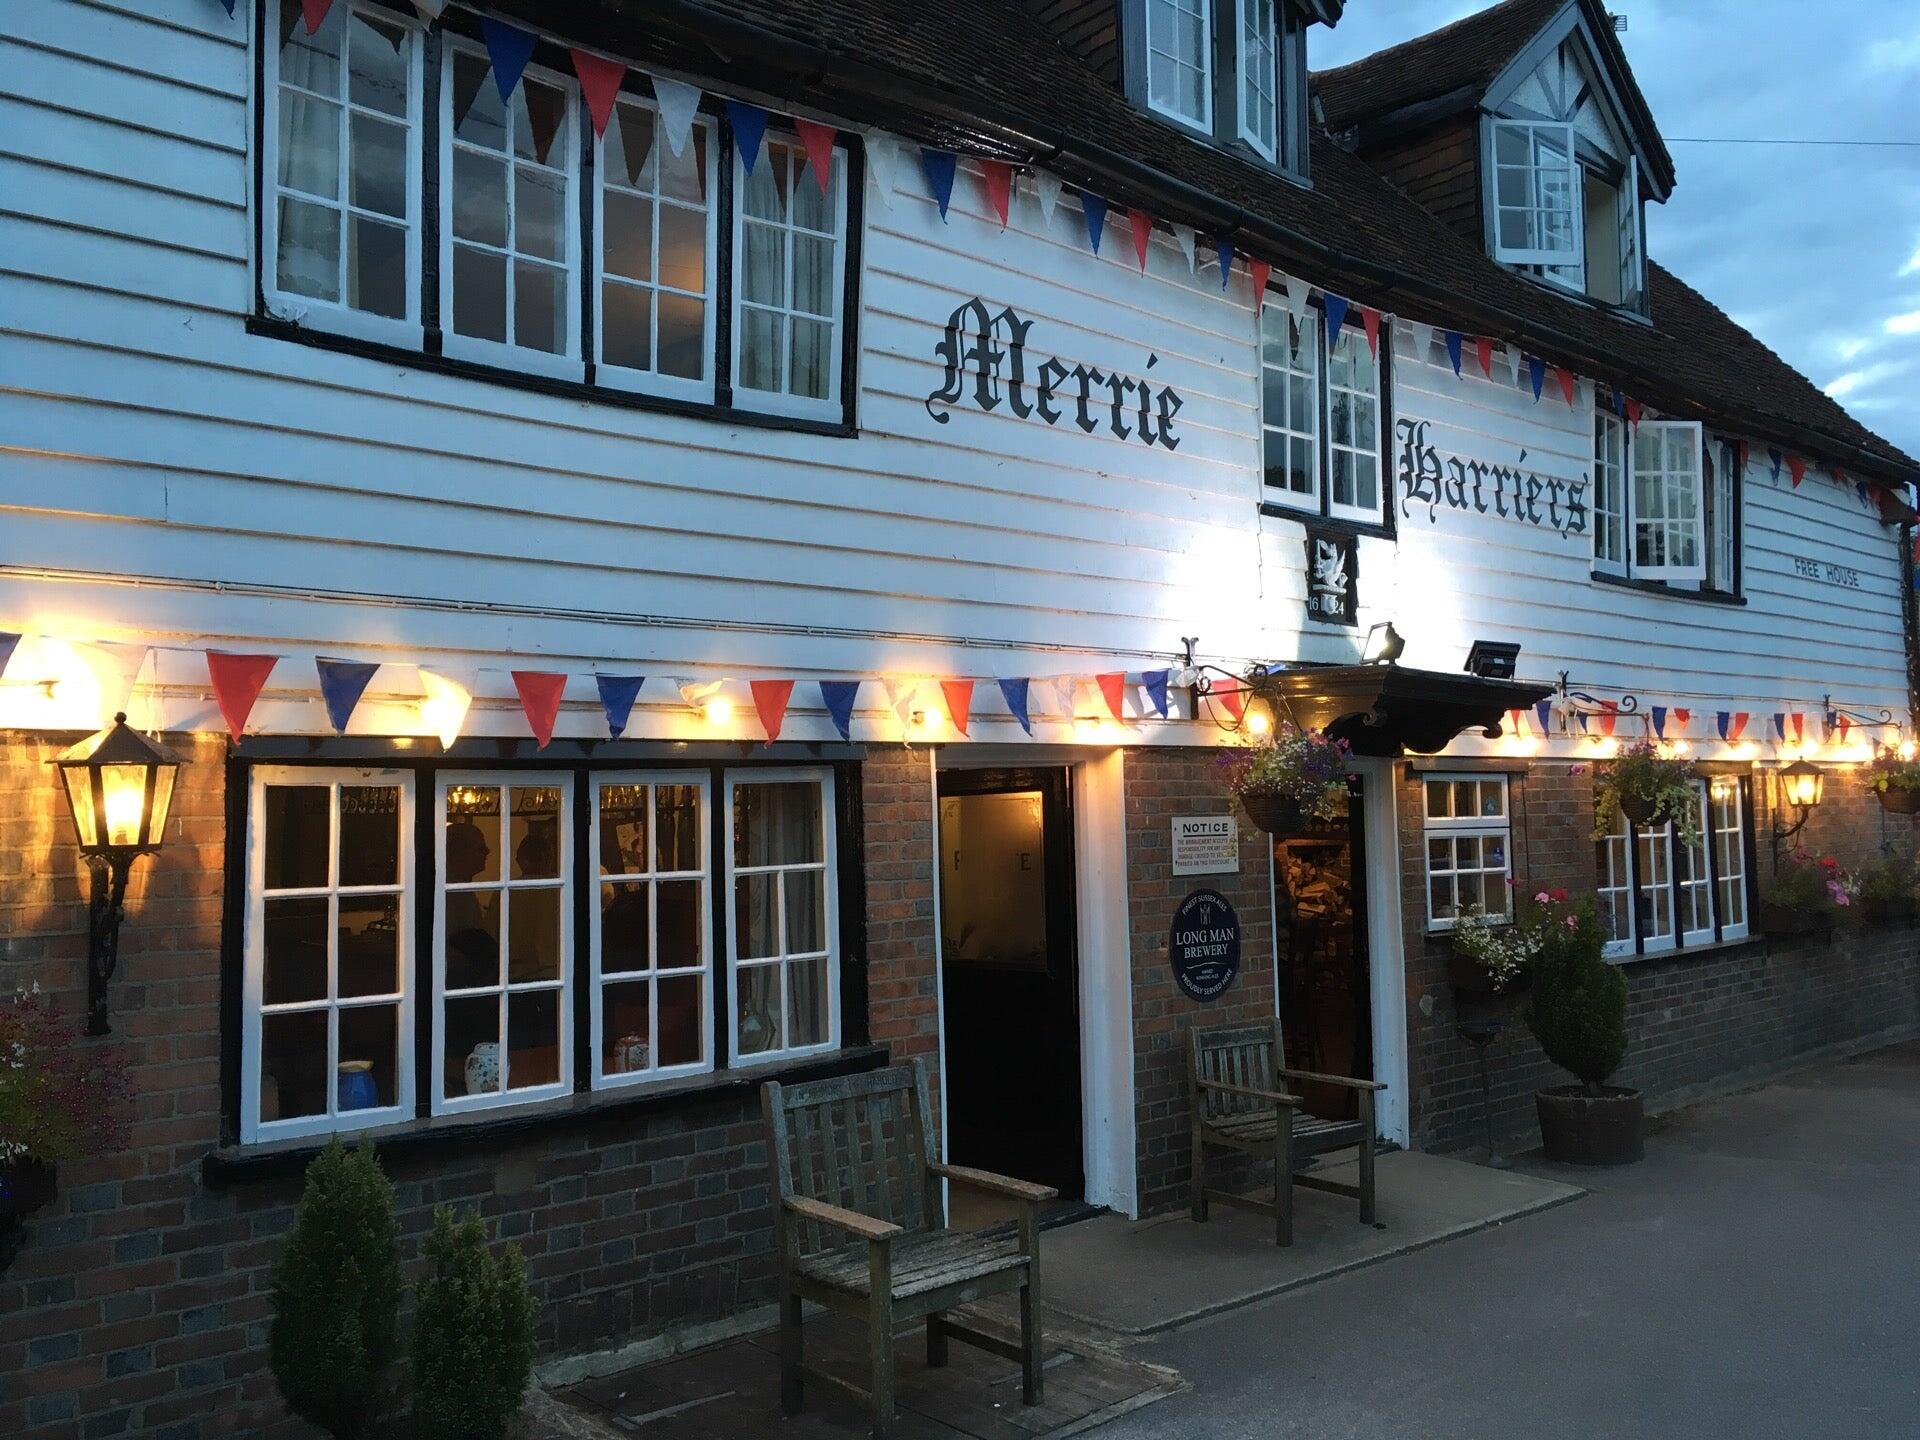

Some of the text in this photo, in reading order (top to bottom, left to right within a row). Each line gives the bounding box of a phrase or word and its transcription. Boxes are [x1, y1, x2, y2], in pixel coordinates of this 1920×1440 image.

[925, 296, 1184, 451] Merrie
[1794, 558, 1860, 587] FREE HOUSE
[1182, 823, 1228, 833] NOTICE
[1181, 894, 1228, 915] FINEST SUSSEX ALES
[1175, 927, 1234, 945] LONG MAN
[1184, 943, 1228, 959] BREWERY
[1181, 972, 1203, 994] PROUDLY
[1203, 983, 1223, 995] SERVED
[1222, 967, 1233, 985] HERE
